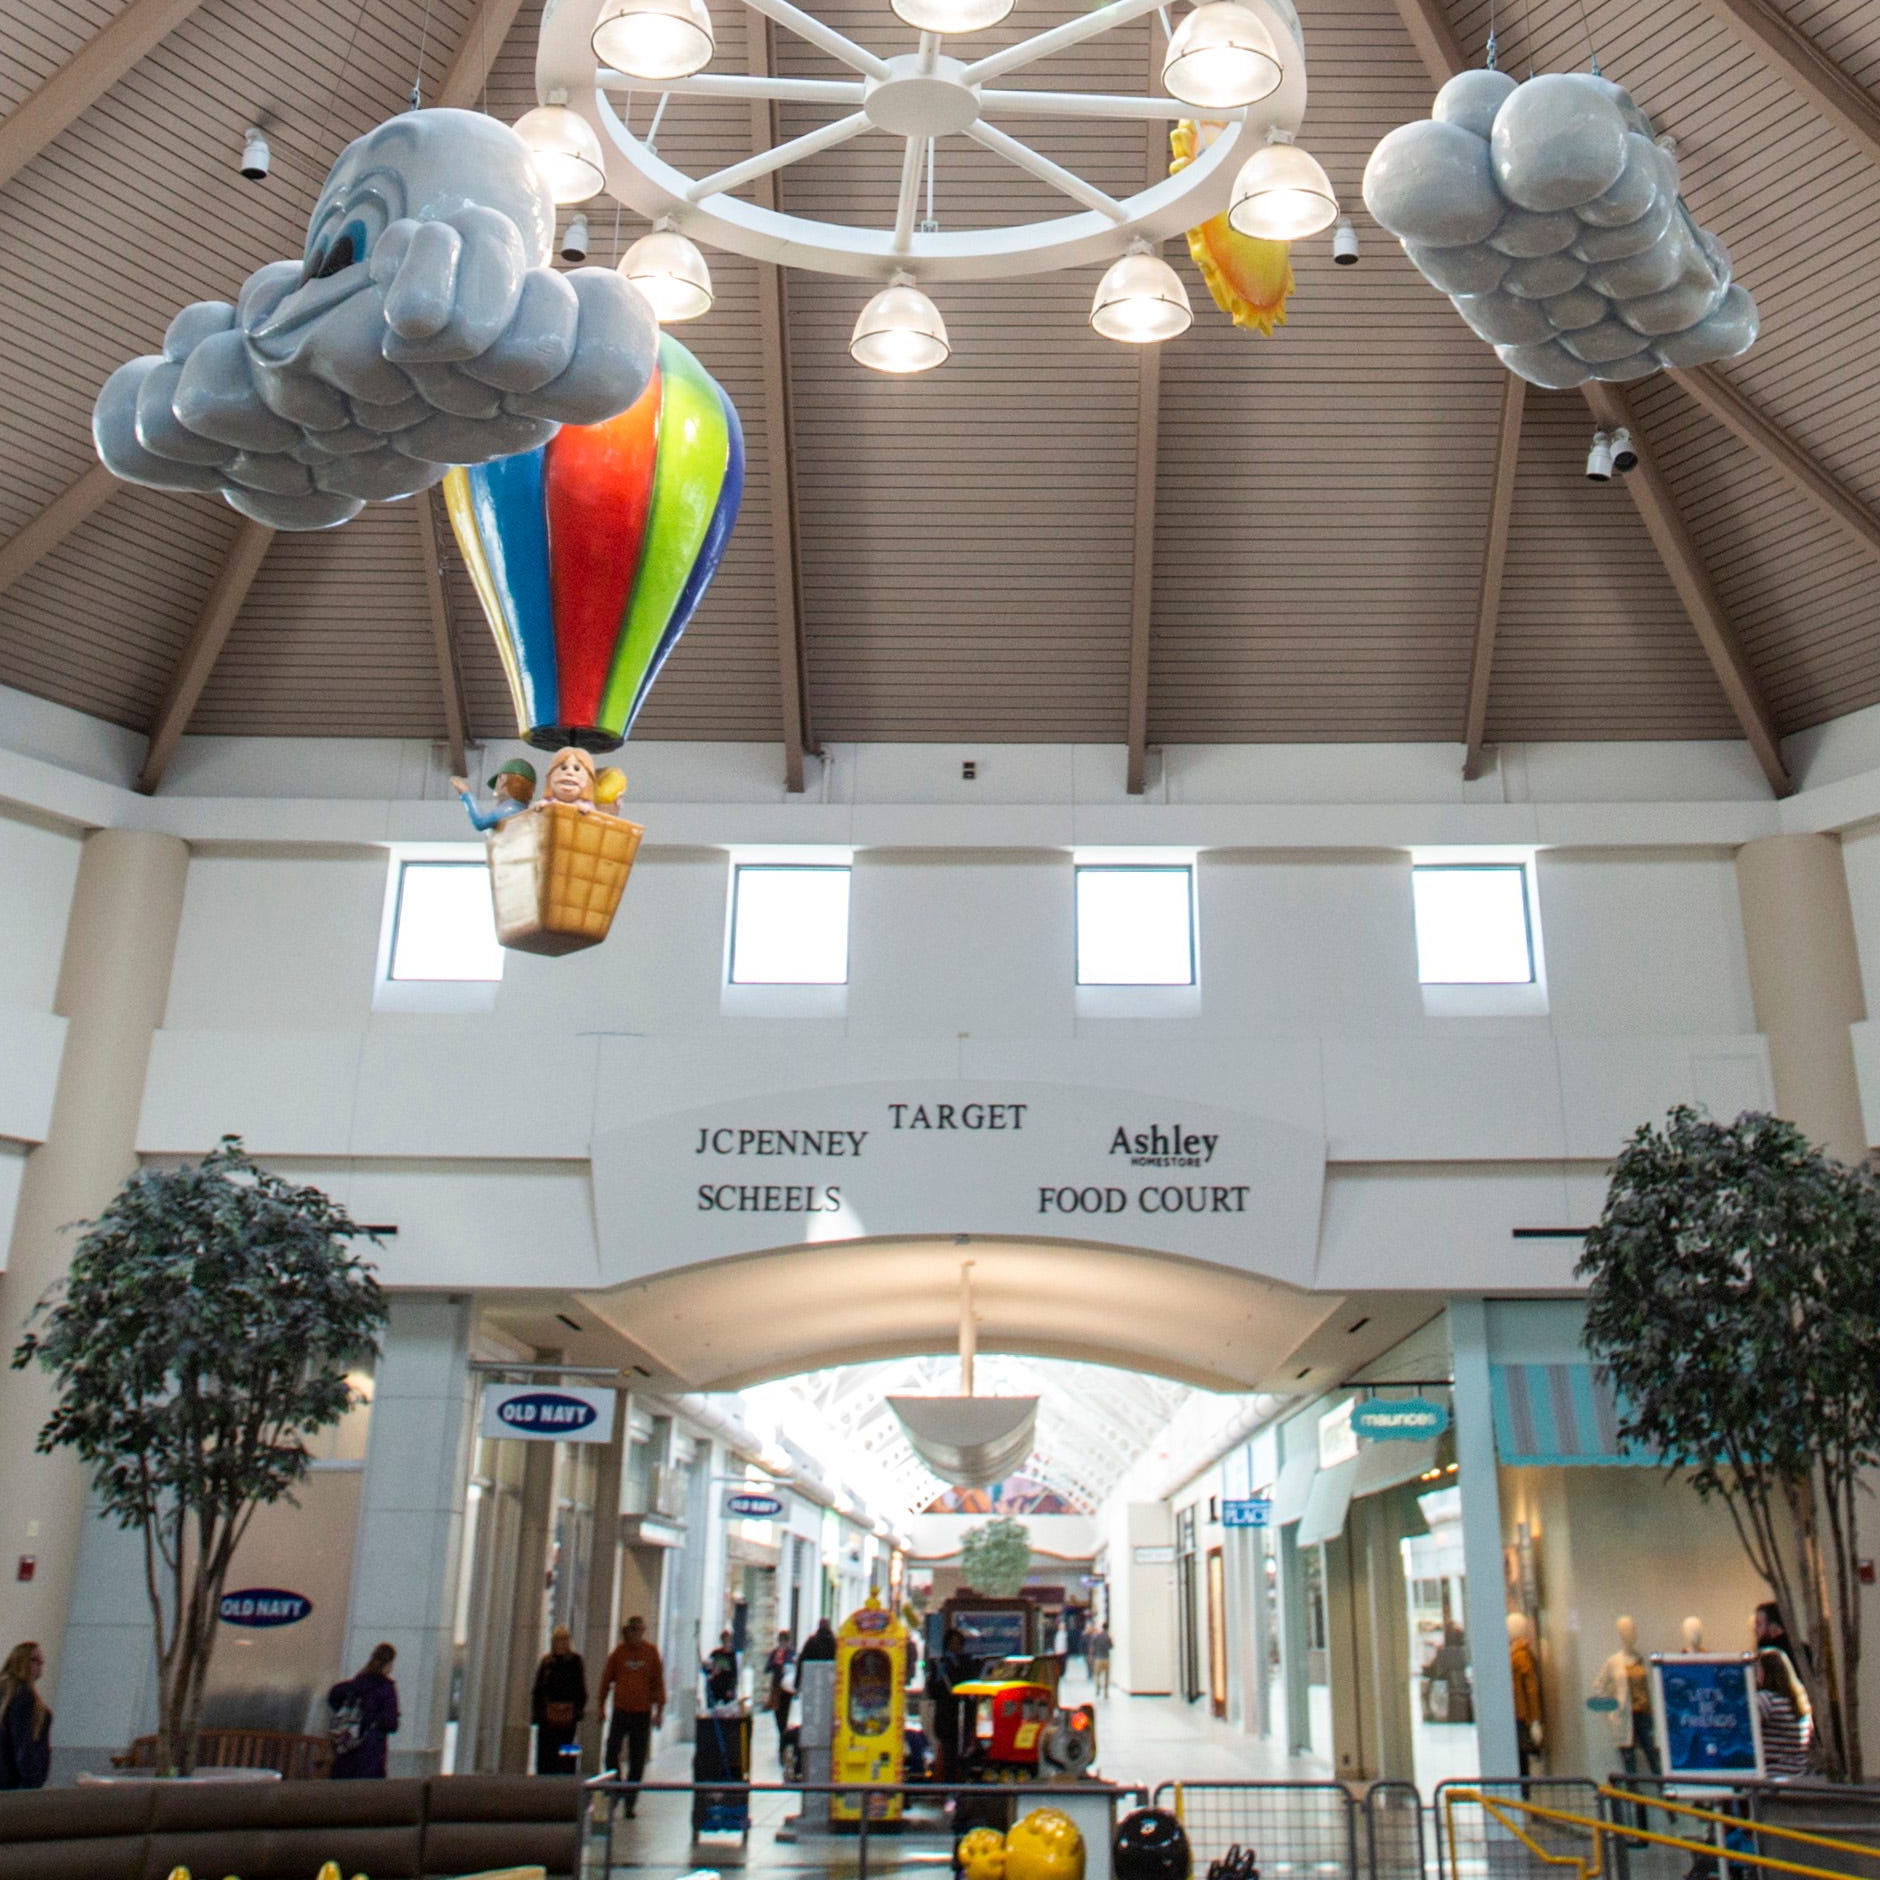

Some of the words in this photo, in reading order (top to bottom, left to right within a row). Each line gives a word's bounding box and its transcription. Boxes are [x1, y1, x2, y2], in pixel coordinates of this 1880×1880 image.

[888, 1103, 1027, 1130] TARGET
[696, 1128, 868, 1156] JCPENNEY
[1109, 1124, 1219, 1163] Ashley
[1131, 1157, 1201, 1168] HOMESTORE
[697, 1185, 841, 1212] SCHEELS
[1038, 1187, 1127, 1214] FOOD
[1139, 1186, 1250, 1213] COURT
[502, 1404, 537, 1421] OLD
[540, 1404, 588, 1423] NAVY
[1361, 1412, 1436, 1427] maurices
[221, 1599, 253, 1616] OLD
[257, 1599, 304, 1617] NAVY
